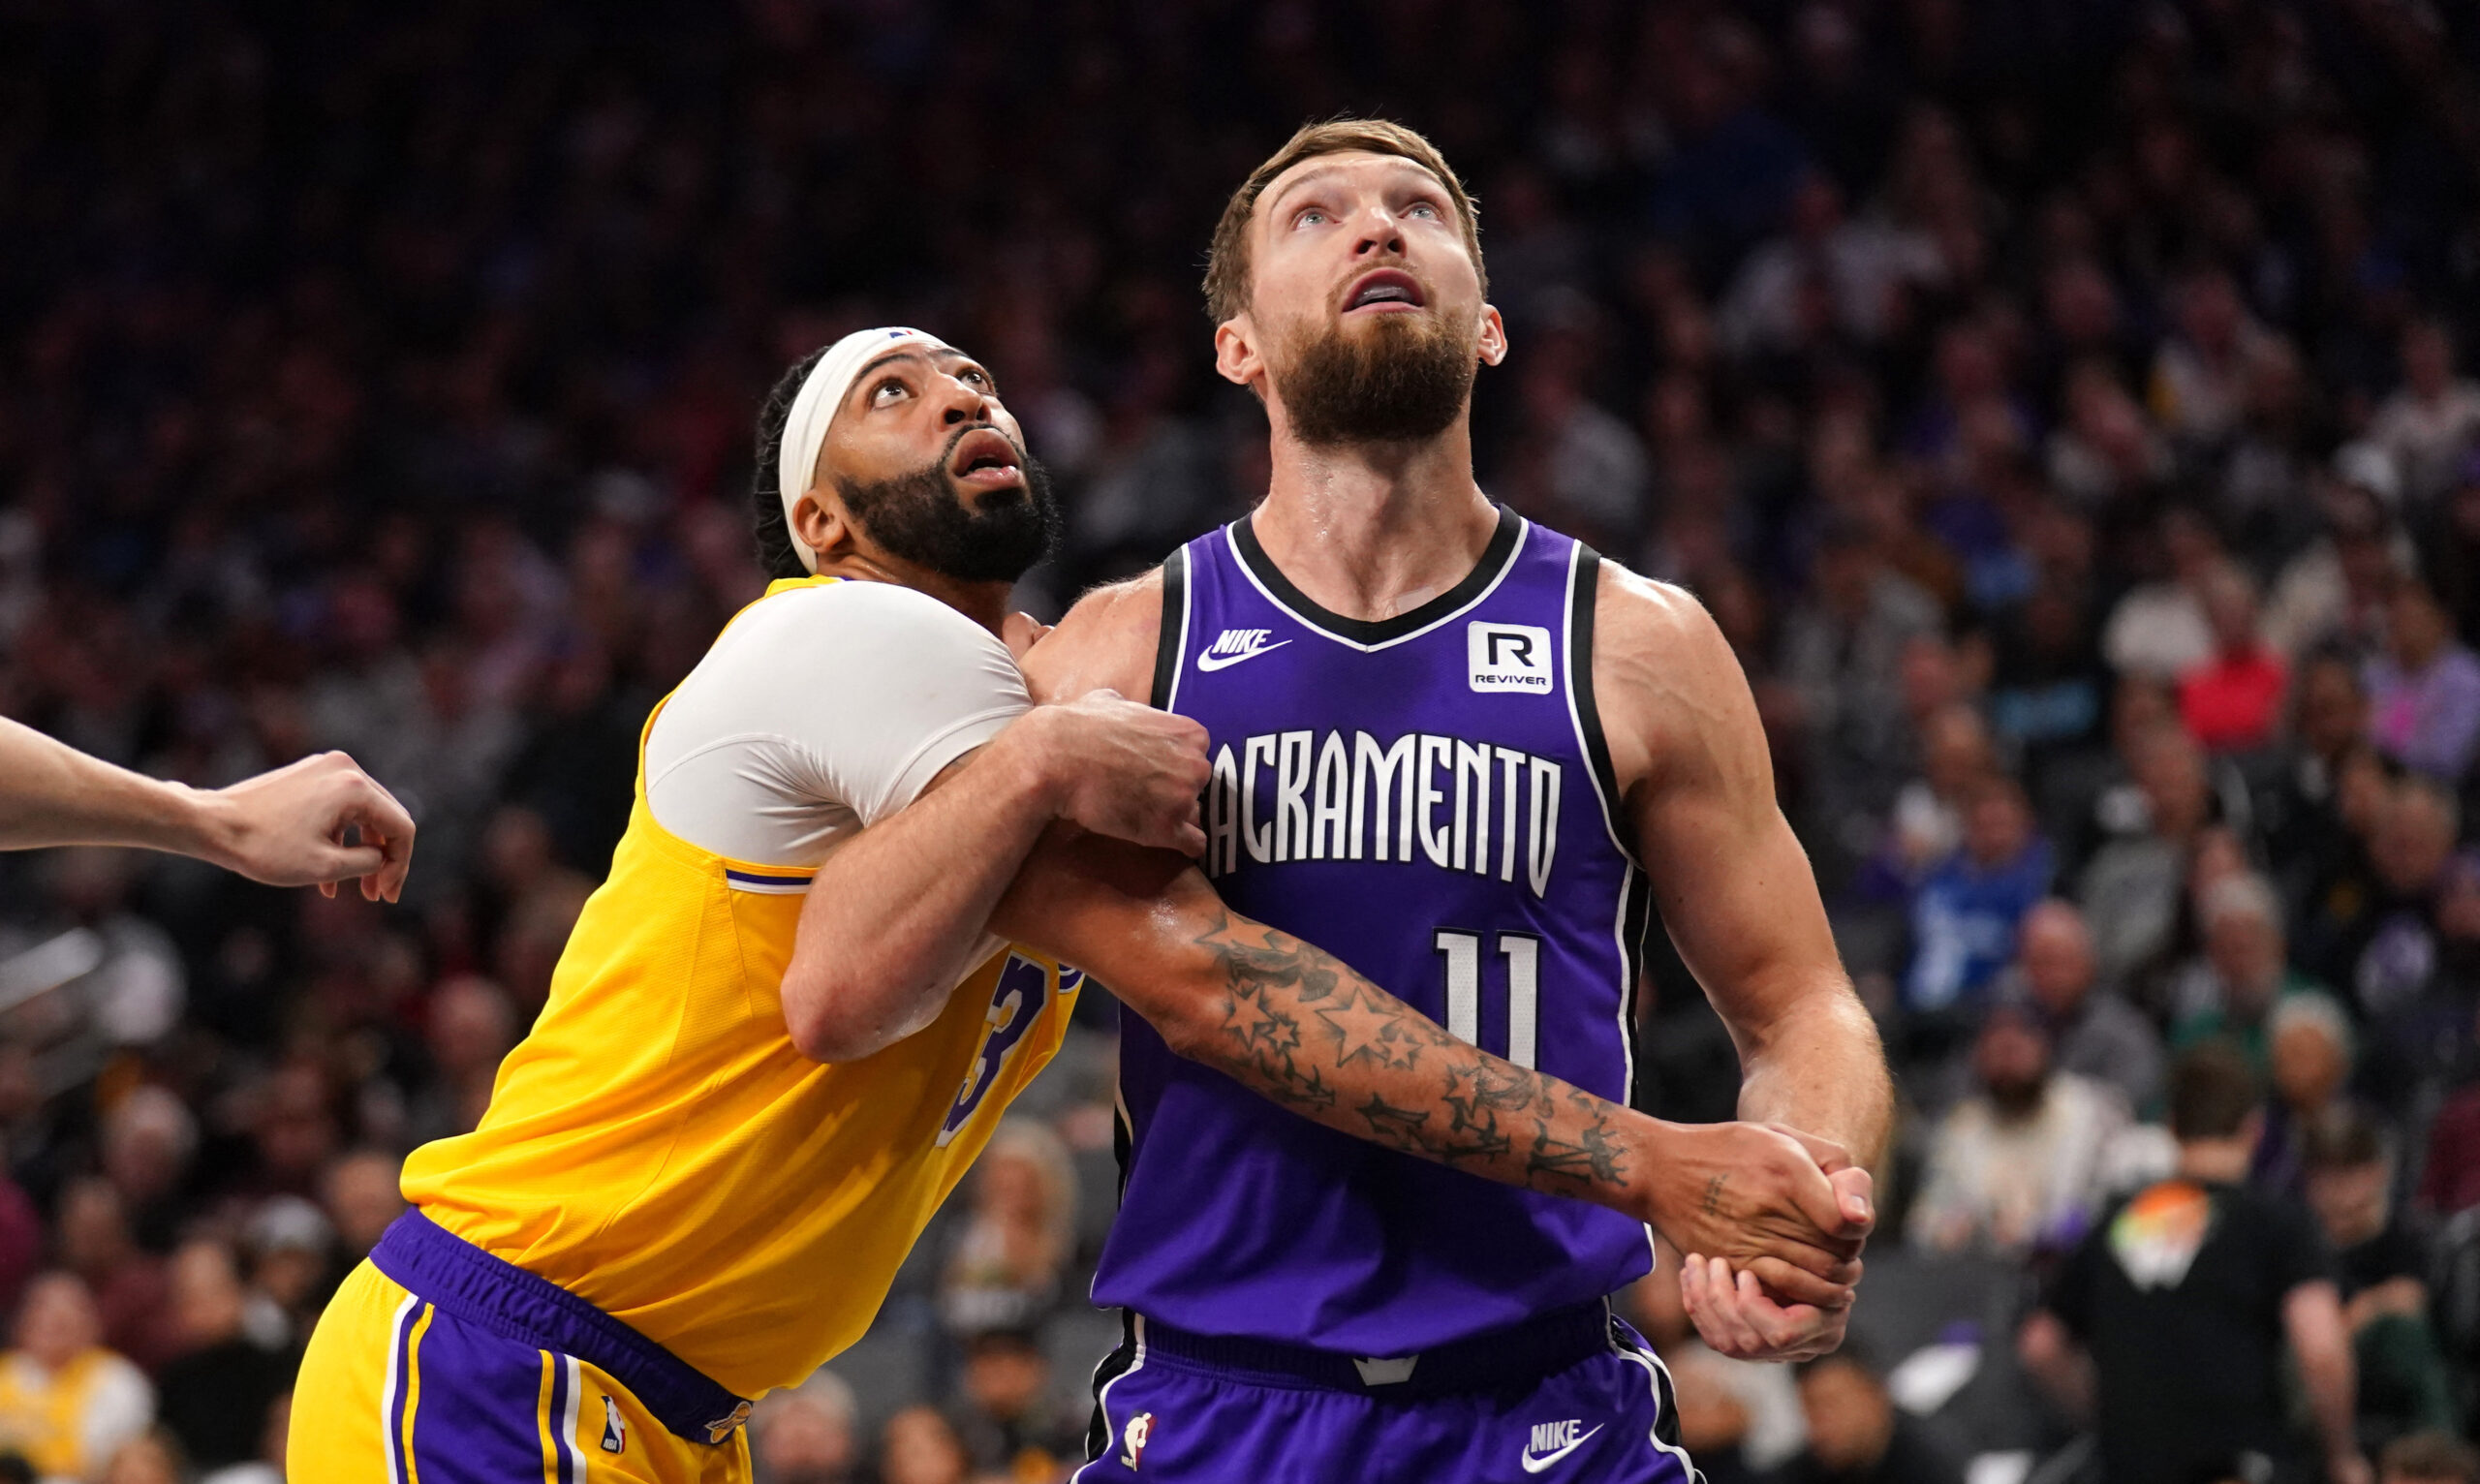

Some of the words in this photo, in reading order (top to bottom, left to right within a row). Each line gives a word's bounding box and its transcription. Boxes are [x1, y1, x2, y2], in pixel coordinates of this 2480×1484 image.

[1211, 628, 1273, 655] NIKE
[1487, 632, 1535, 667] R
[1474, 674, 1547, 686] REVIVER
[1201, 728, 1563, 900] ACRAMENTO
[1435, 929, 1540, 1072] 11
[933, 950, 1049, 1148] 3
[603, 1438, 618, 1451] NBA
[1531, 1419, 1582, 1453] NIKE
